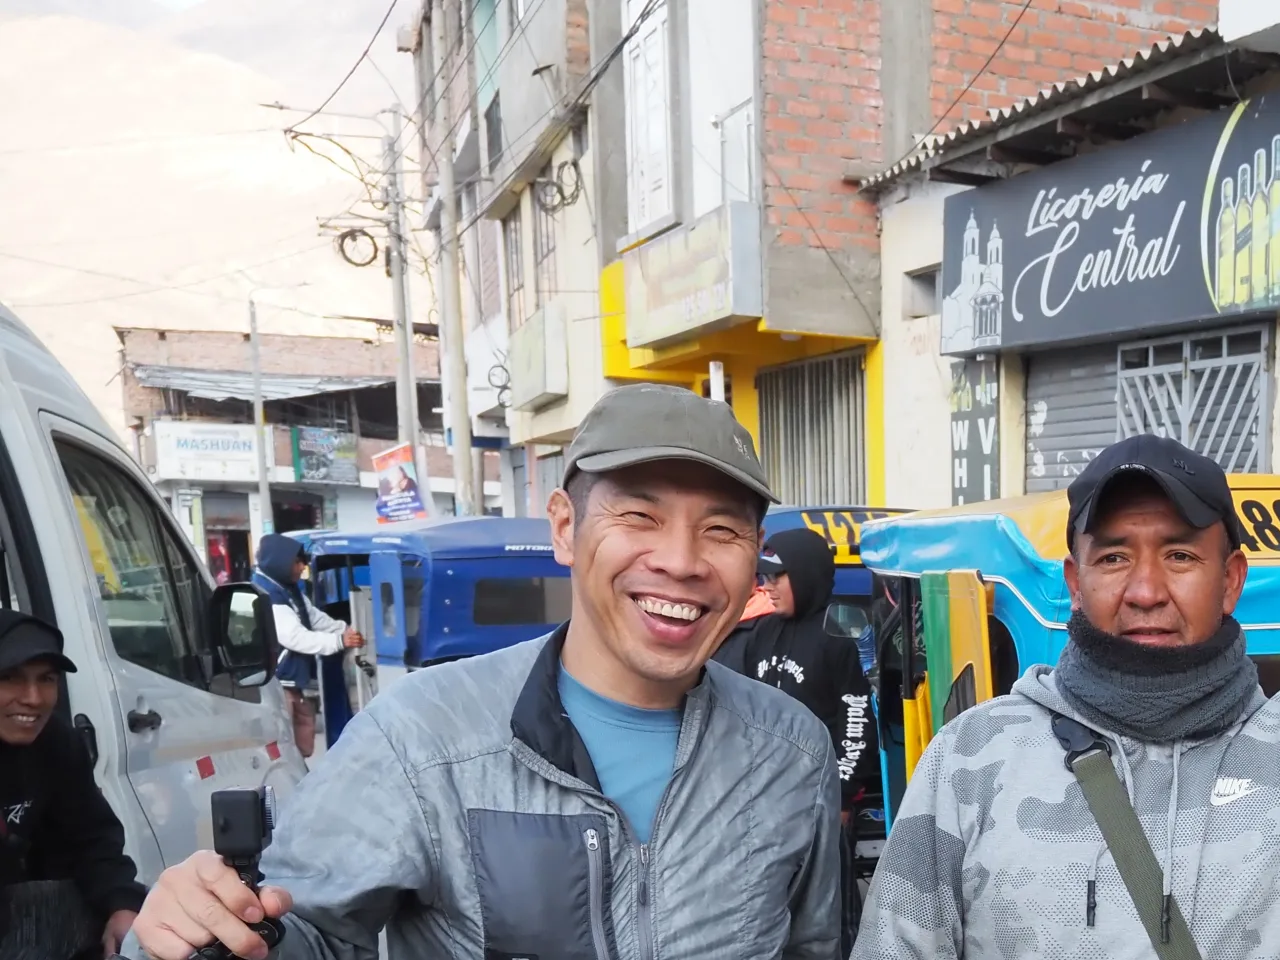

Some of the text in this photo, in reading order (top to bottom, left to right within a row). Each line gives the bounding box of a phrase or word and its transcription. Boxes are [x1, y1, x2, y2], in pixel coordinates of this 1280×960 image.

[1011, 200, 1187, 322] Central
[841, 693, 869, 738] Palm
[1214, 778, 1252, 794] NIKE
